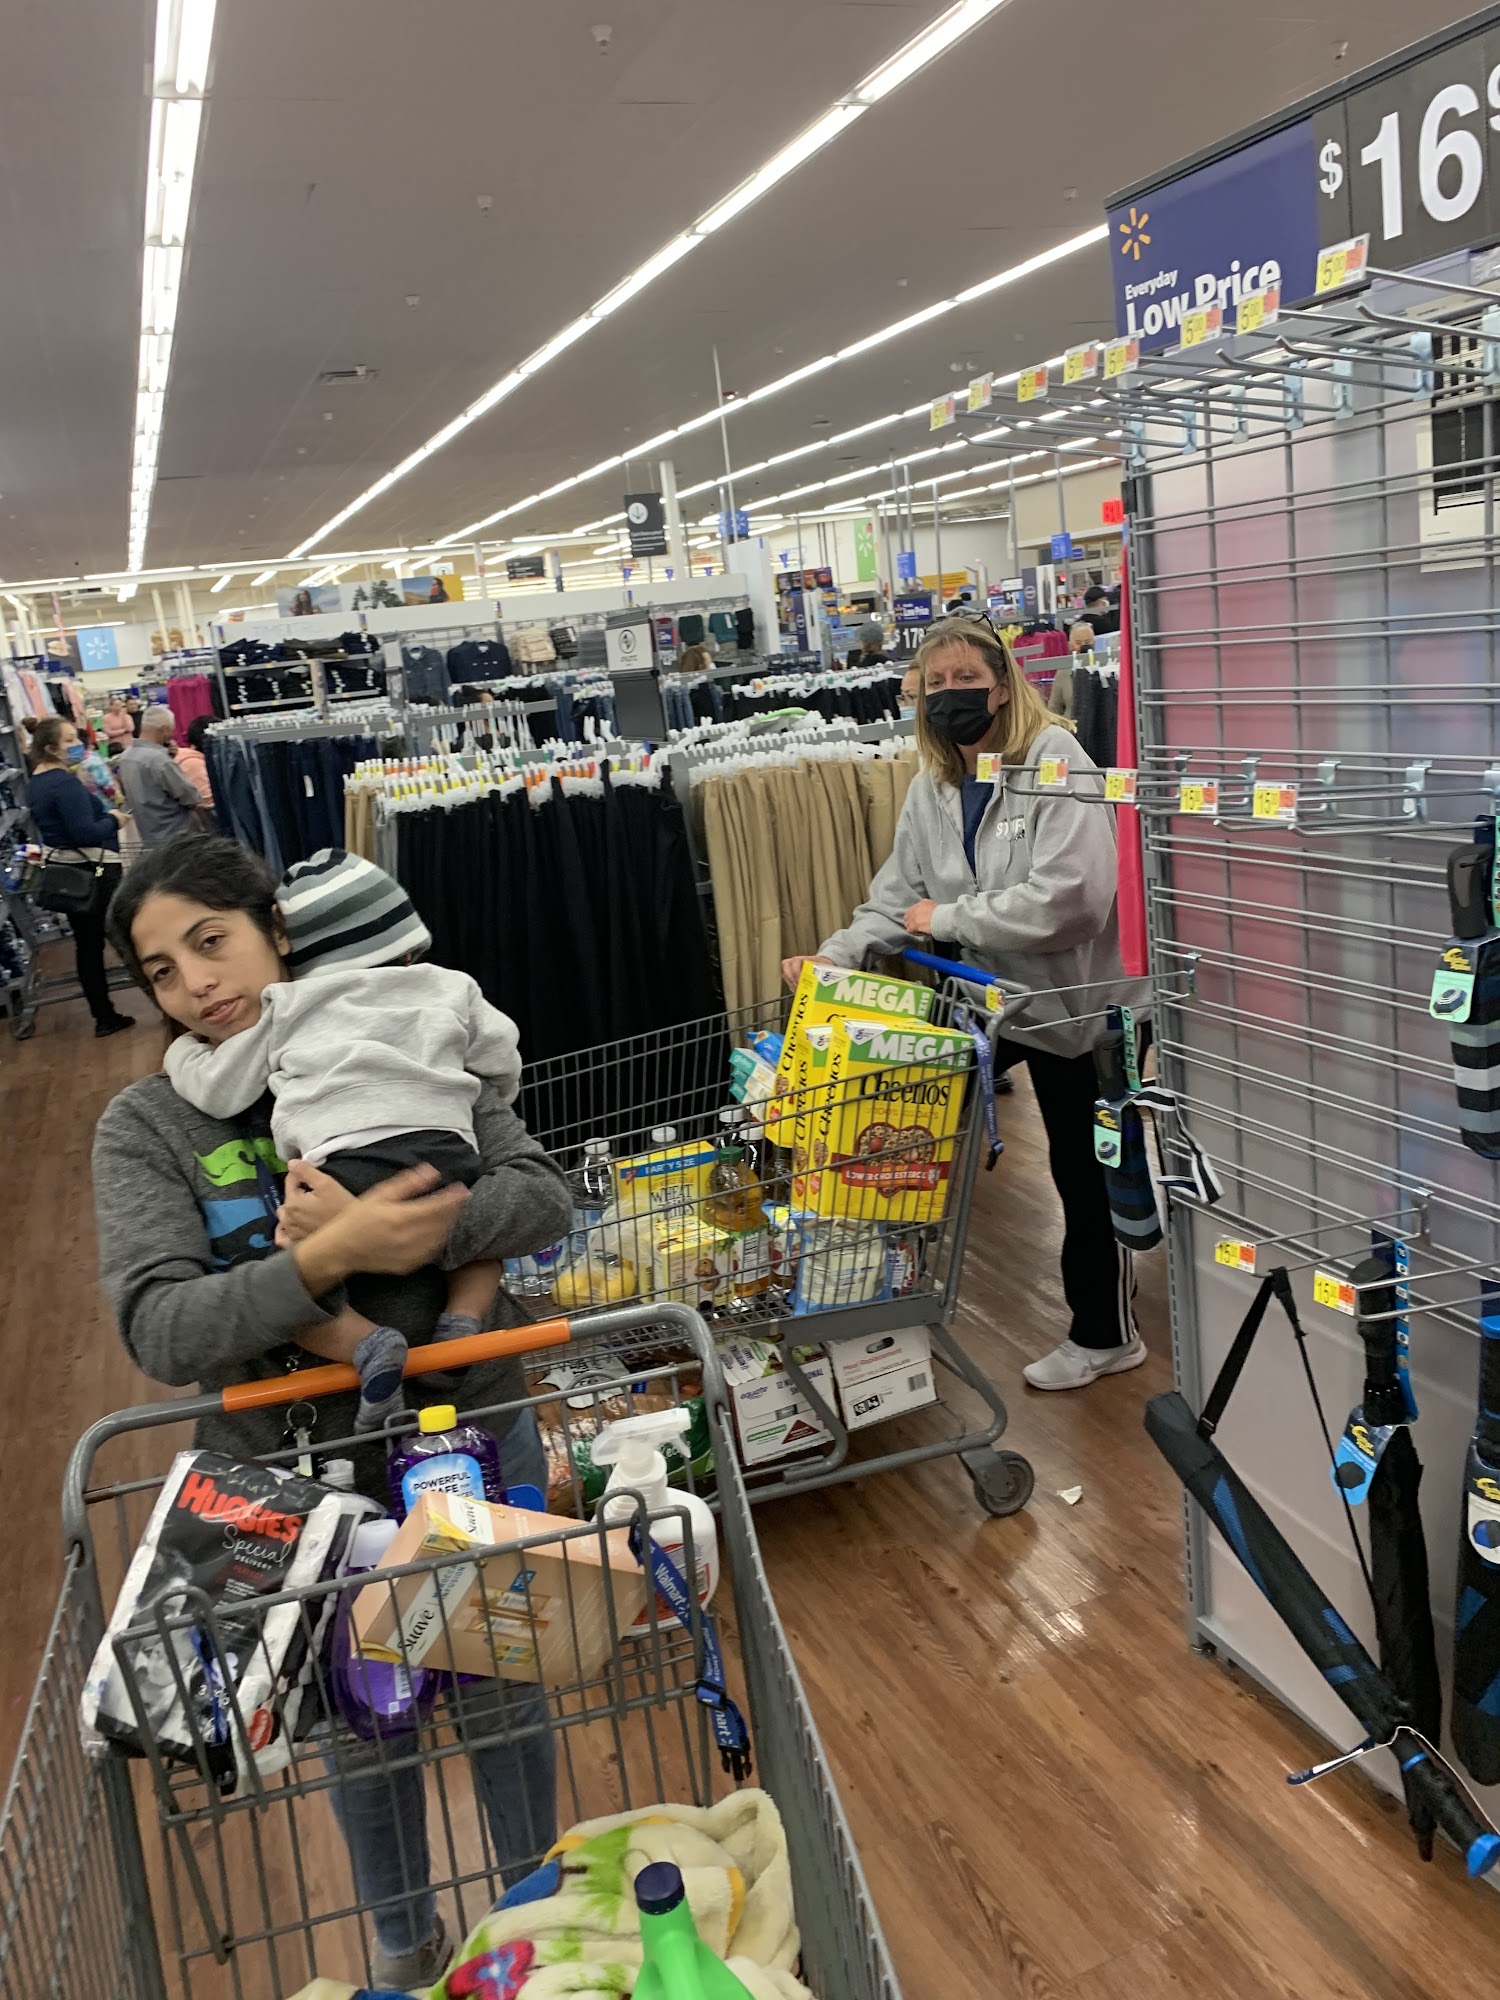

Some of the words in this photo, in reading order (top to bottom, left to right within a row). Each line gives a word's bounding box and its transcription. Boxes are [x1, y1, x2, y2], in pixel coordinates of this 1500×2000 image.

[1125, 269, 1178, 300] Everyday
[1126, 292, 1190, 338] Low
[1195, 260, 1282, 312] Price
[833, 978, 917, 1016] MEGA
[868, 1034, 955, 1067] MEGA
[645, 1162, 674, 1175] PARY
[413, 1471, 472, 1491] POWERFUL
[430, 1483, 459, 1494] AFE
[177, 1472, 302, 1544] HUGGIES
[222, 1523, 293, 1568] Special
[234, 1554, 273, 1571] DELIVERY
[654, 1562, 687, 1606] Walmart
[397, 1608, 435, 1653] Suave
